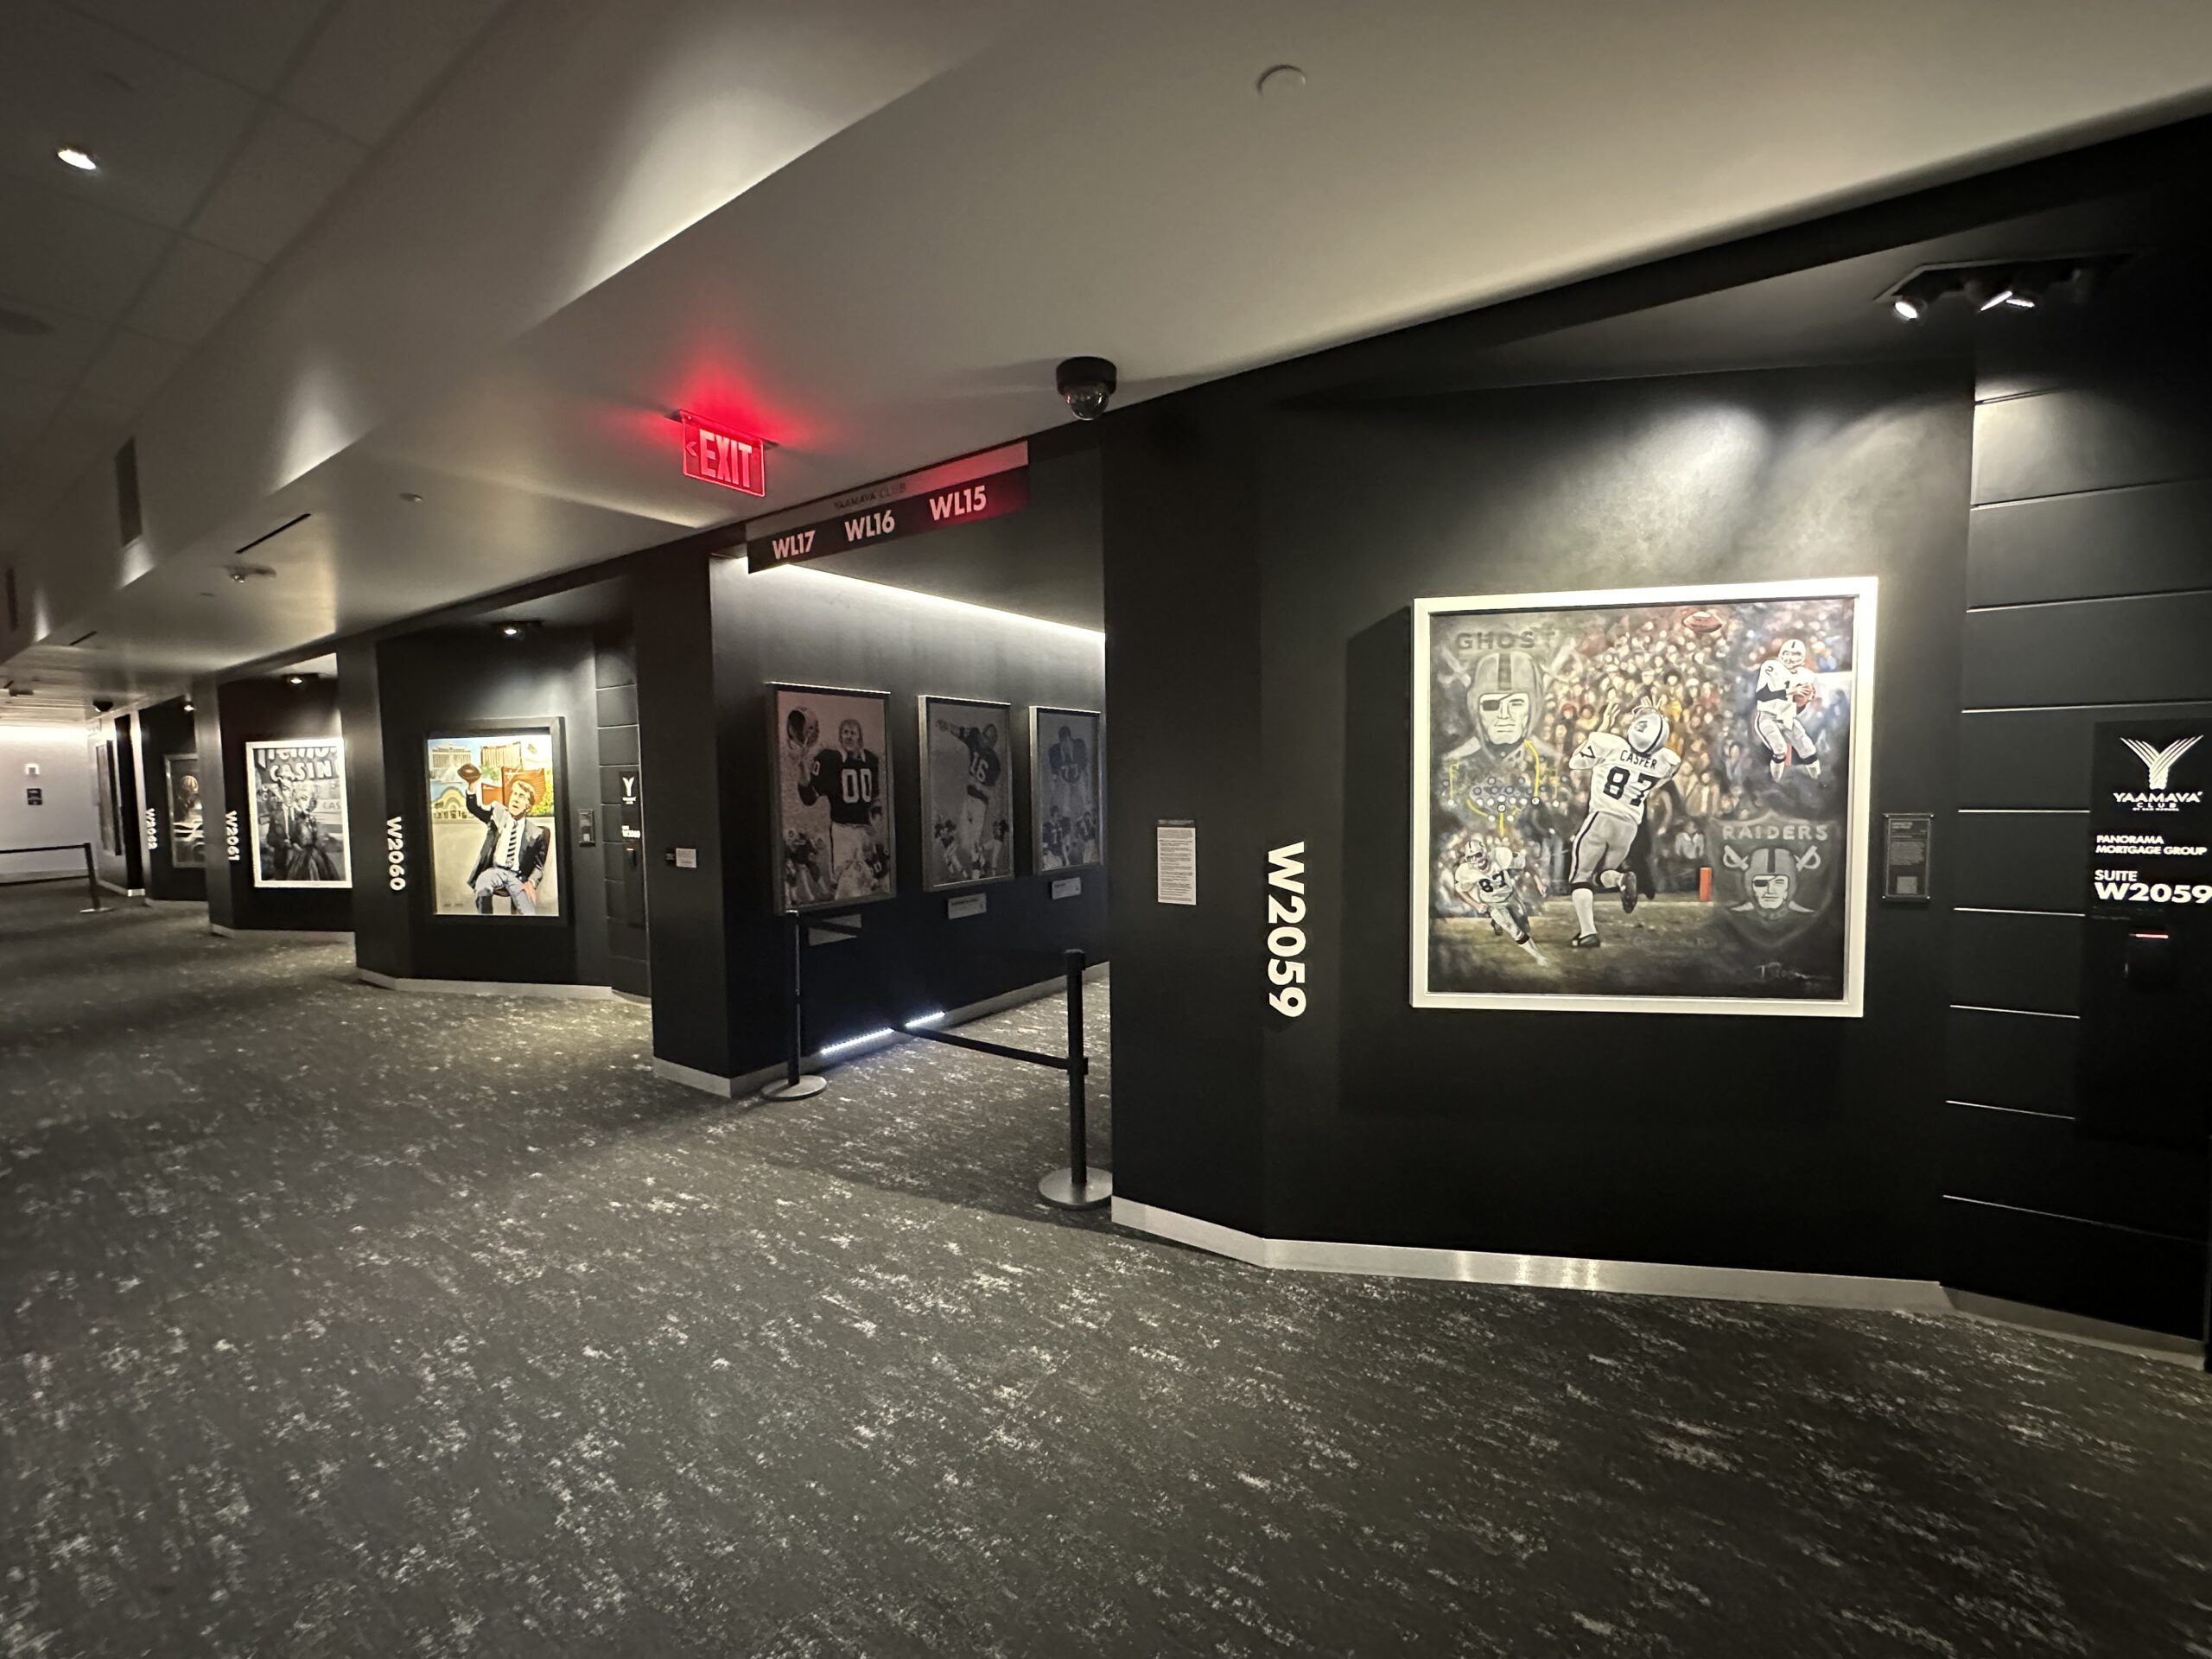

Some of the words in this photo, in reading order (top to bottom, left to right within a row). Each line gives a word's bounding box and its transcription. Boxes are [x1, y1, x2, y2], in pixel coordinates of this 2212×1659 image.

[699, 429, 753, 488] EXIT
[878, 482, 906, 499] CLUB
[772, 531, 816, 559] WL17
[844, 510, 895, 542] WL16
[929, 486, 987, 520] WL15
[270, 760, 340, 782] CASIN
[969, 751, 988, 782] 16
[1619, 750, 1657, 770] CASPER
[842, 768, 873, 804] 00
[1603, 766, 1660, 807] 87
[225, 810, 240, 861] W2061
[1721, 825, 1828, 841] RAIDERS
[2096, 835, 2164, 844] PANORAMA
[386, 817, 406, 891] W2060
[2095, 845, 2162, 855] MORTGAGE
[2163, 846, 2208, 855] GROUP
[2094, 869, 2139, 882] SUITE
[2094, 882, 2212, 904] W2059
[1267, 841, 1306, 1018] W2059
